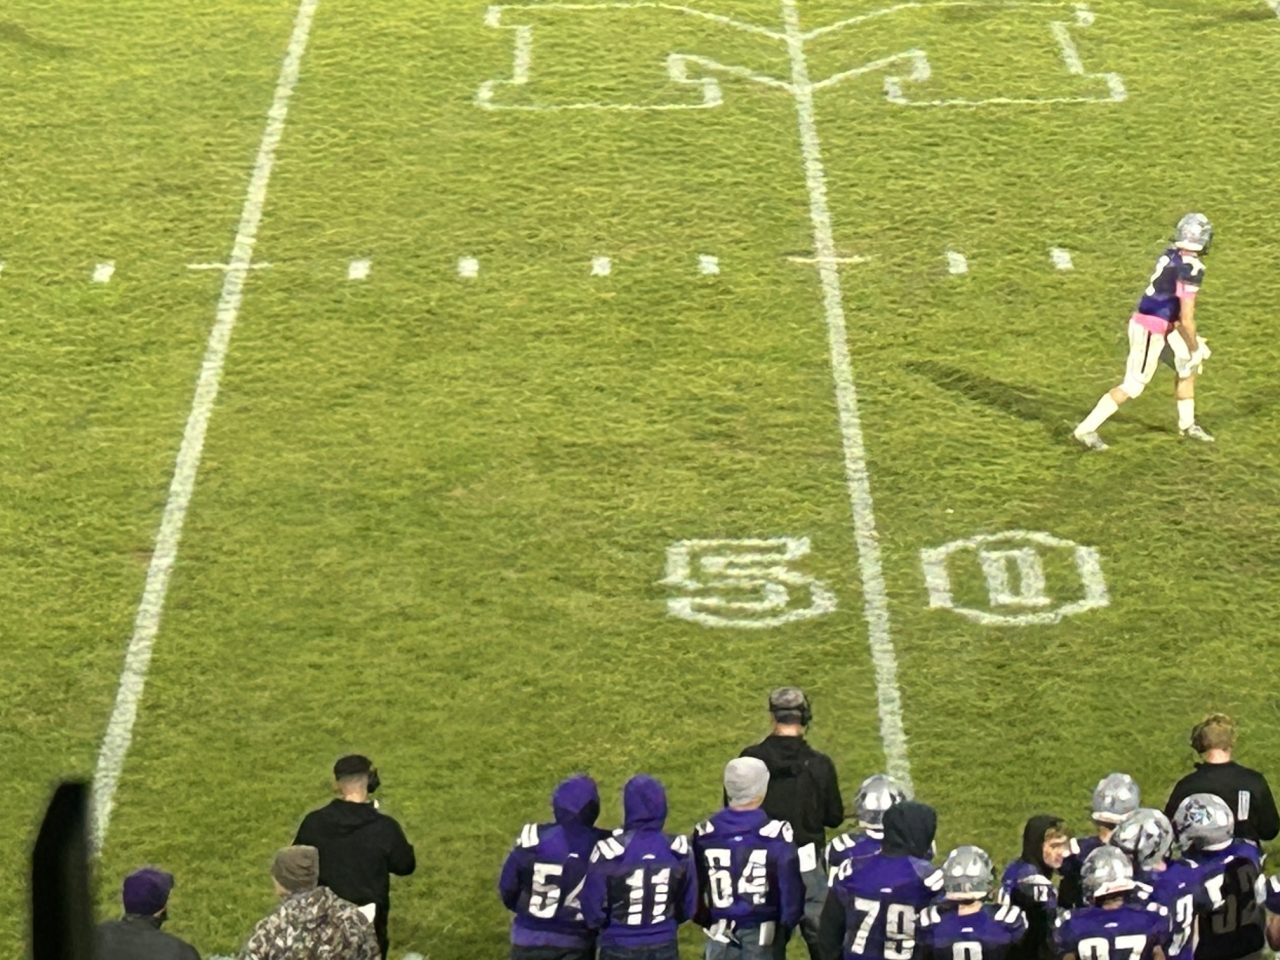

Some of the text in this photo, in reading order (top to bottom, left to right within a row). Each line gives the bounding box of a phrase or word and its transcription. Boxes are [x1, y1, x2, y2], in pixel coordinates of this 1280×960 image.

[625, 867, 672, 925] 11
[704, 848, 770, 908] 64
[851, 897, 916, 960] 79
